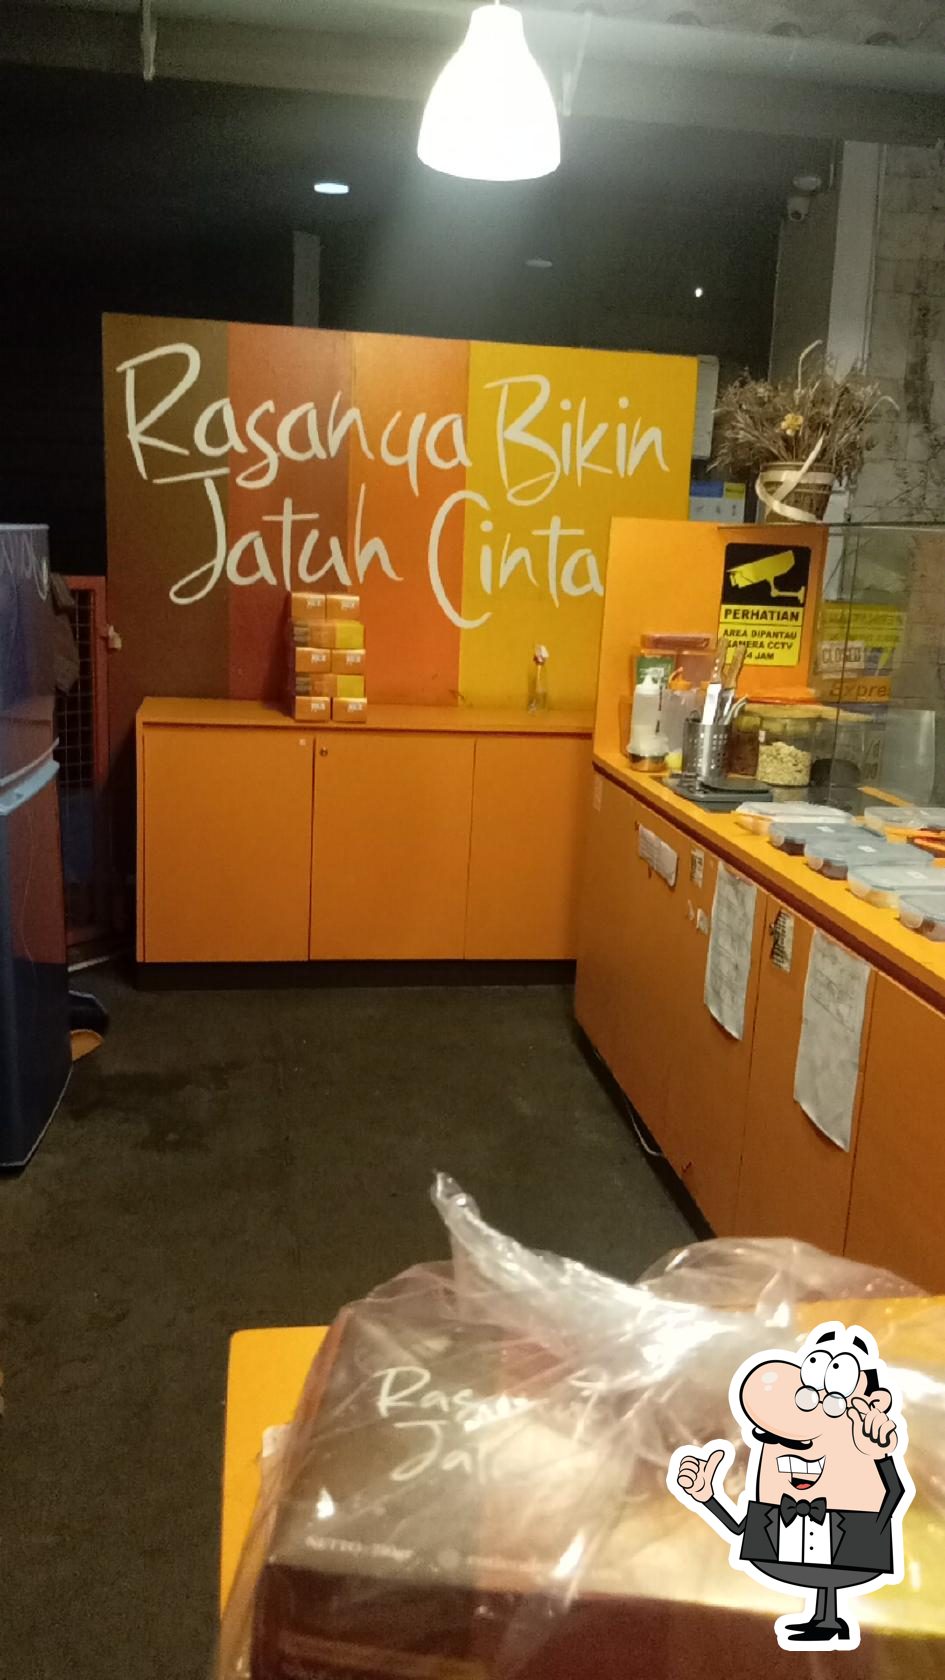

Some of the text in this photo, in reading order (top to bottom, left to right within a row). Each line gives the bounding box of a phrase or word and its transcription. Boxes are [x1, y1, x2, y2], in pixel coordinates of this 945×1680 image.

[116, 342, 670, 506] Rasanya Bikin
[153, 467, 403, 604] Jatuh
[428, 490, 604, 629] Cinta
[724, 608, 800, 622] PERHATIAN
[723, 628, 797, 639] AREA DIPANTAU
[767, 641, 793, 649] CCTV
